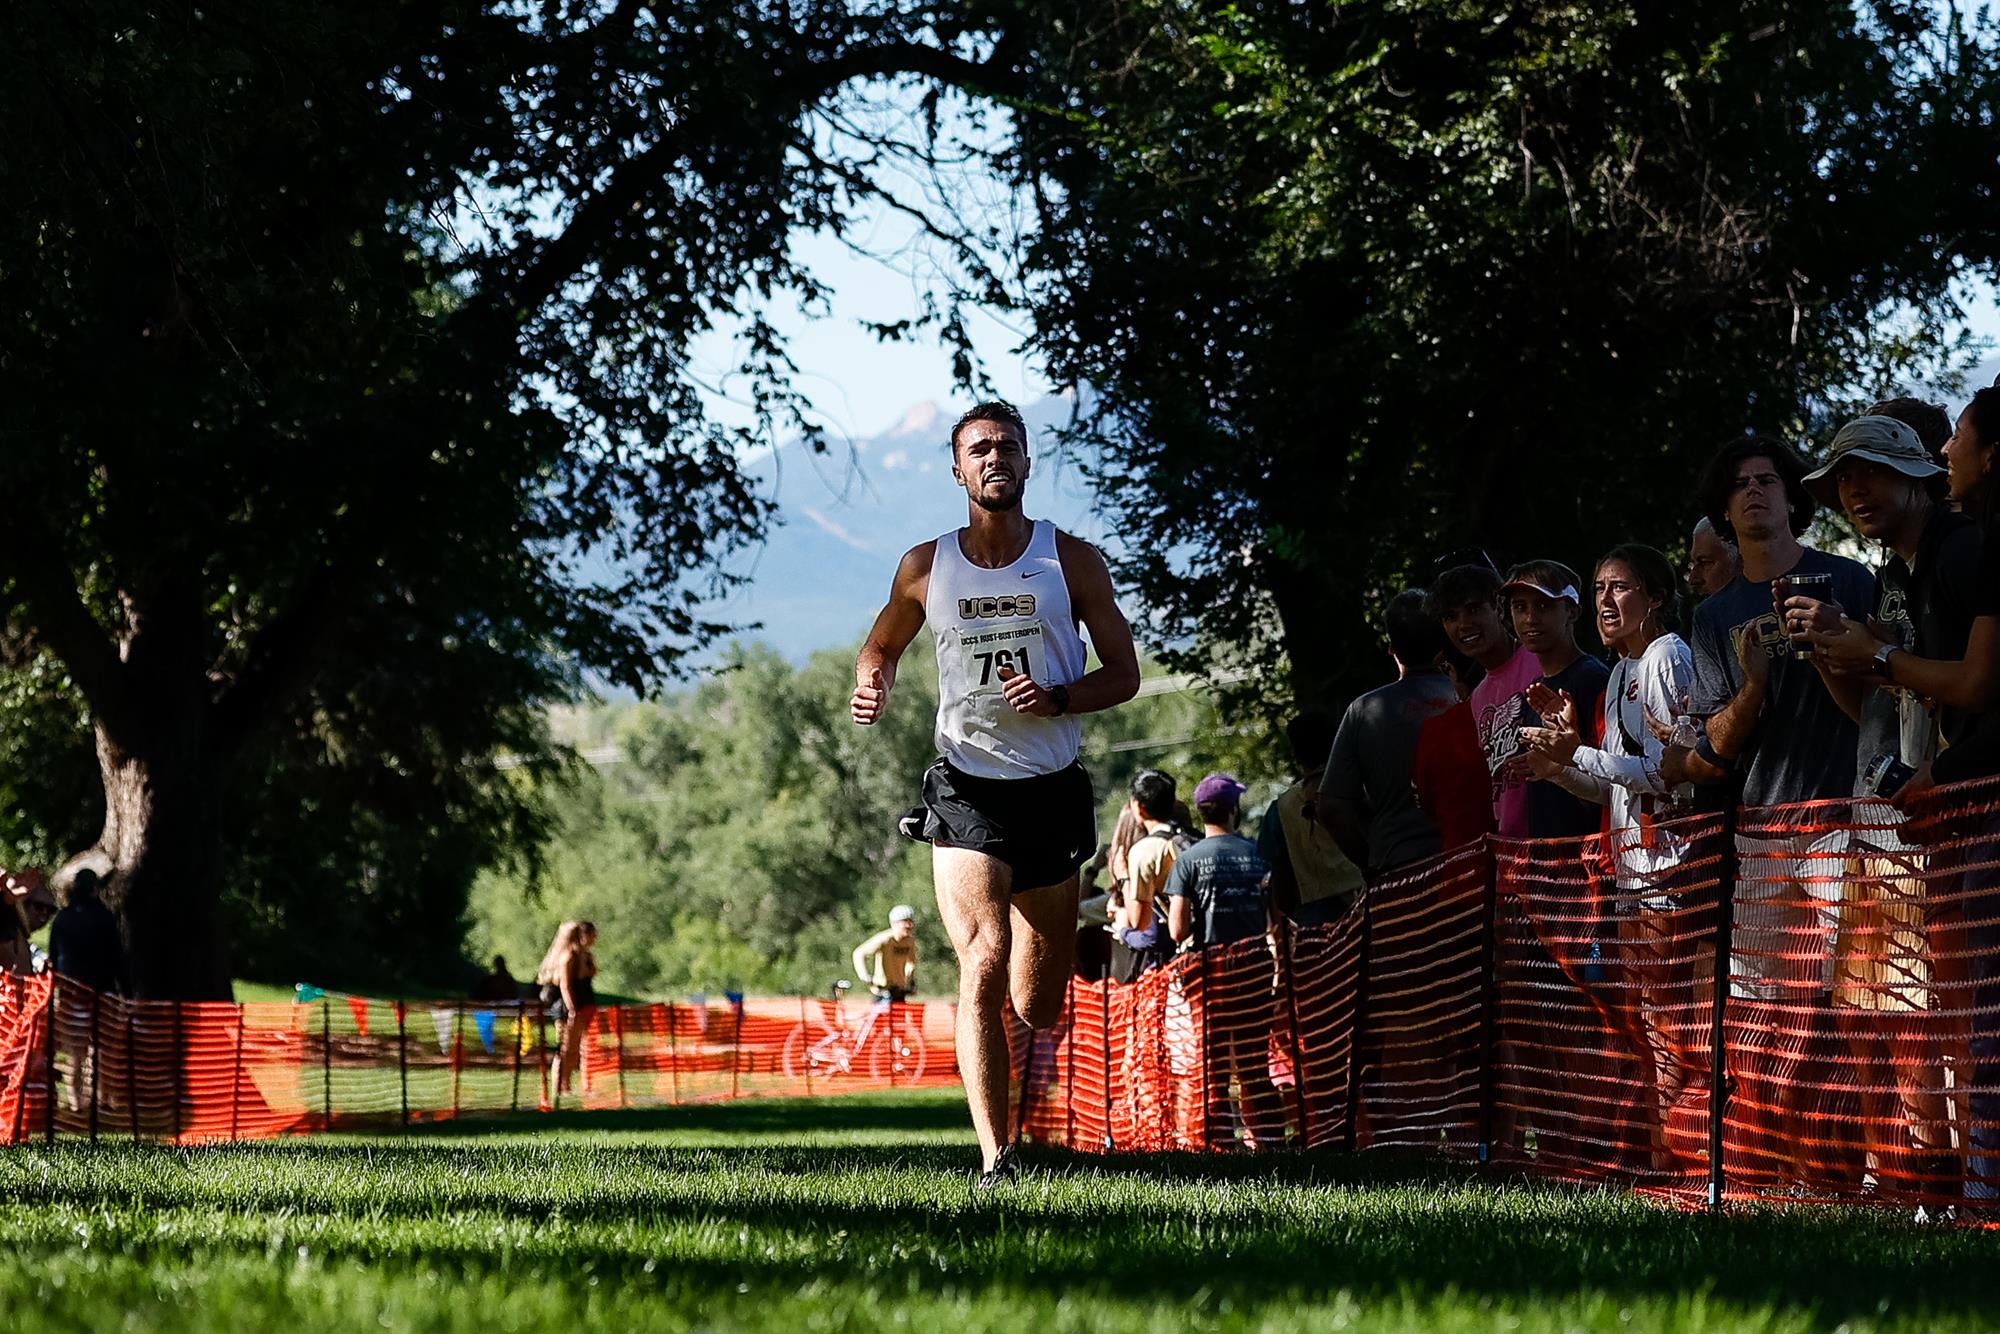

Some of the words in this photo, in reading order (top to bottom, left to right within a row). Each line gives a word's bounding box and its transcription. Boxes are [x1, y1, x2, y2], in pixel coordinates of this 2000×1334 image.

[959, 595, 1036, 619] UCCS
[960, 636, 979, 646] UCCS
[974, 647, 1031, 685] 761
